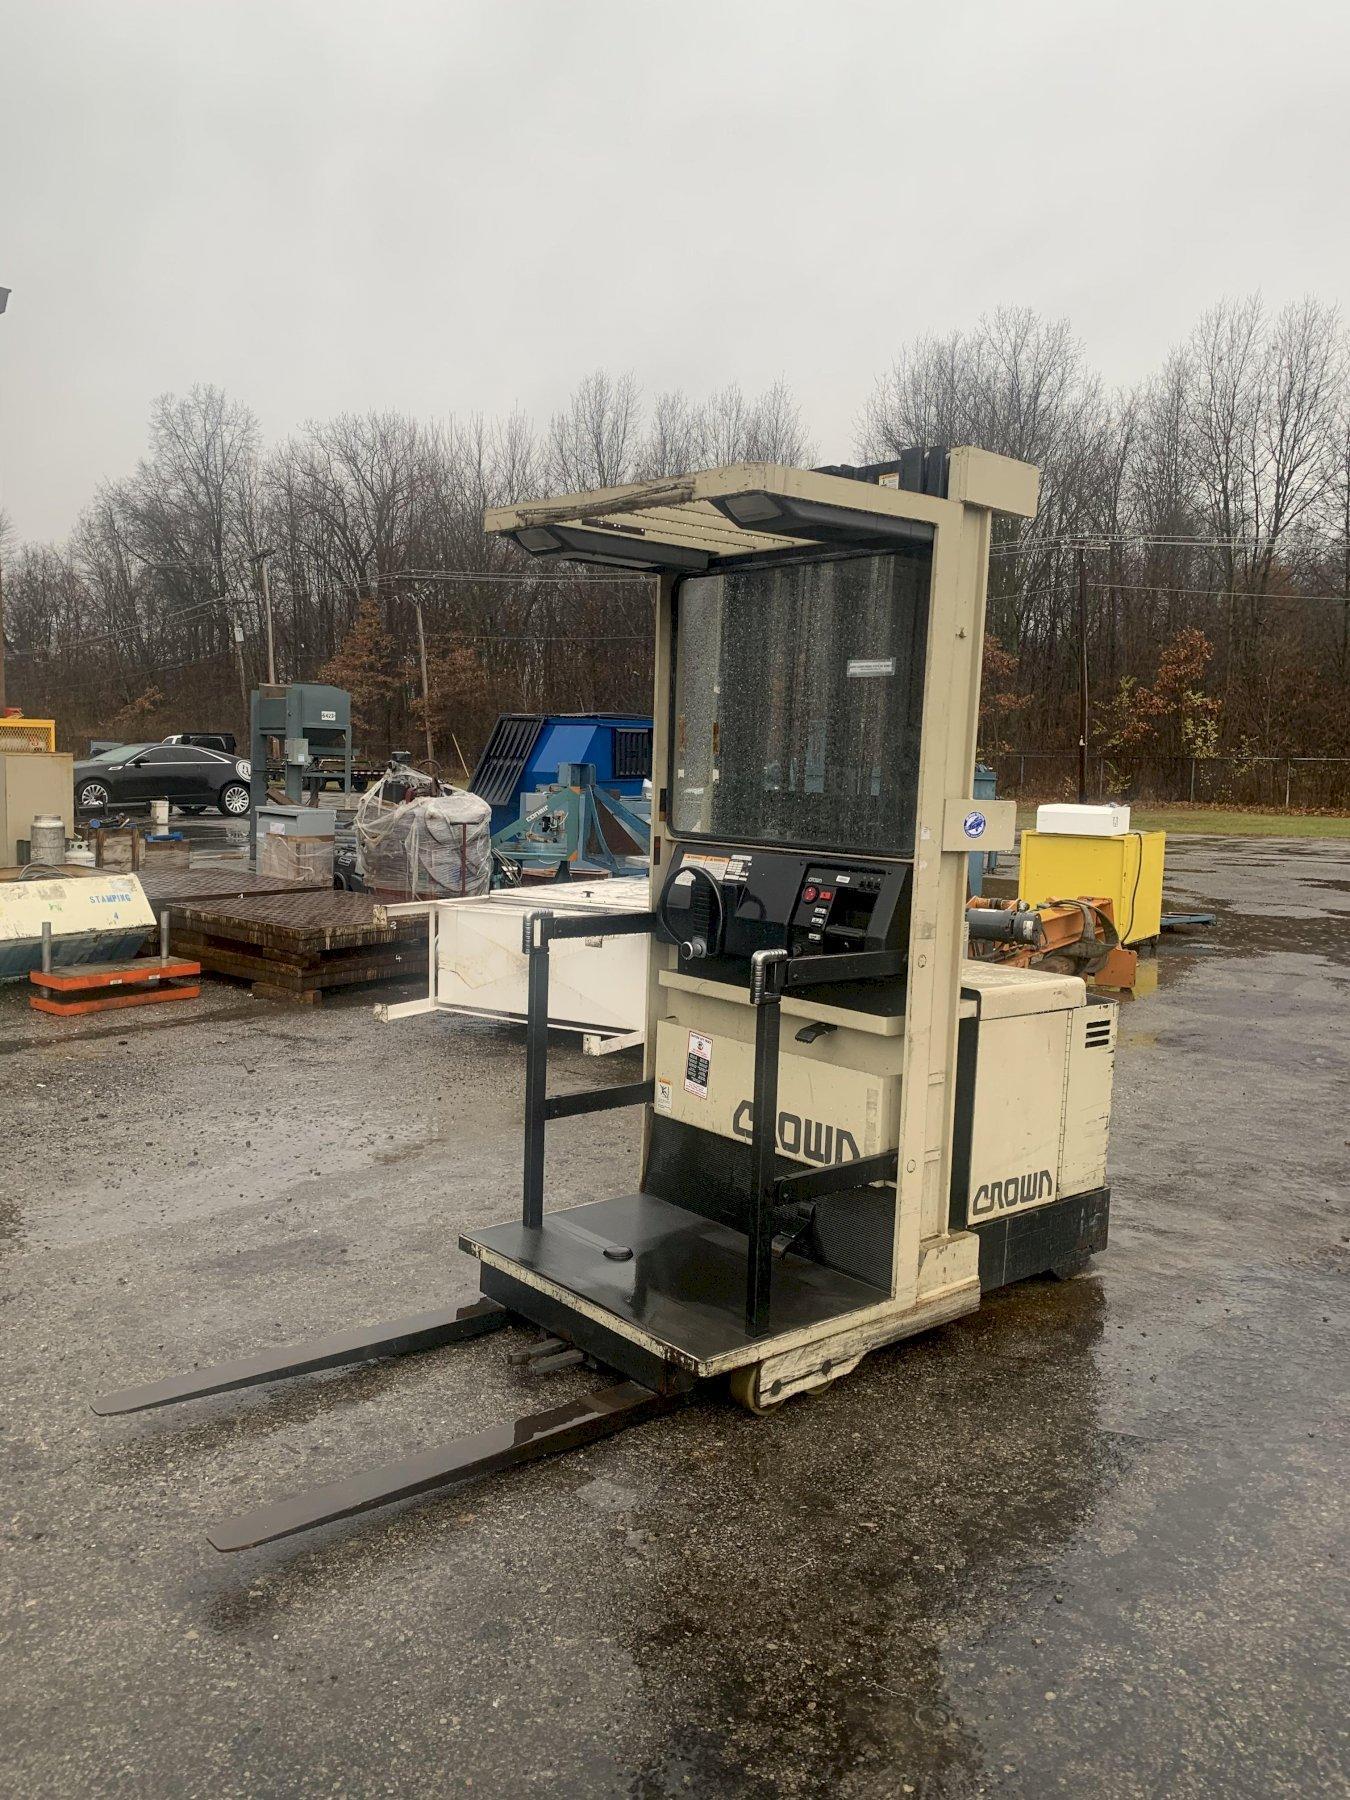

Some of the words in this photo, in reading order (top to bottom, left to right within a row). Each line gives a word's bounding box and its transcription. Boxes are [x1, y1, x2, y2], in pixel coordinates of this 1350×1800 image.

[89, 894, 131, 904] STAMPING
[395, 954, 402, 963] 4
[733, 1100, 861, 1165] COWN
[973, 1170, 1052, 1216] CROWN
